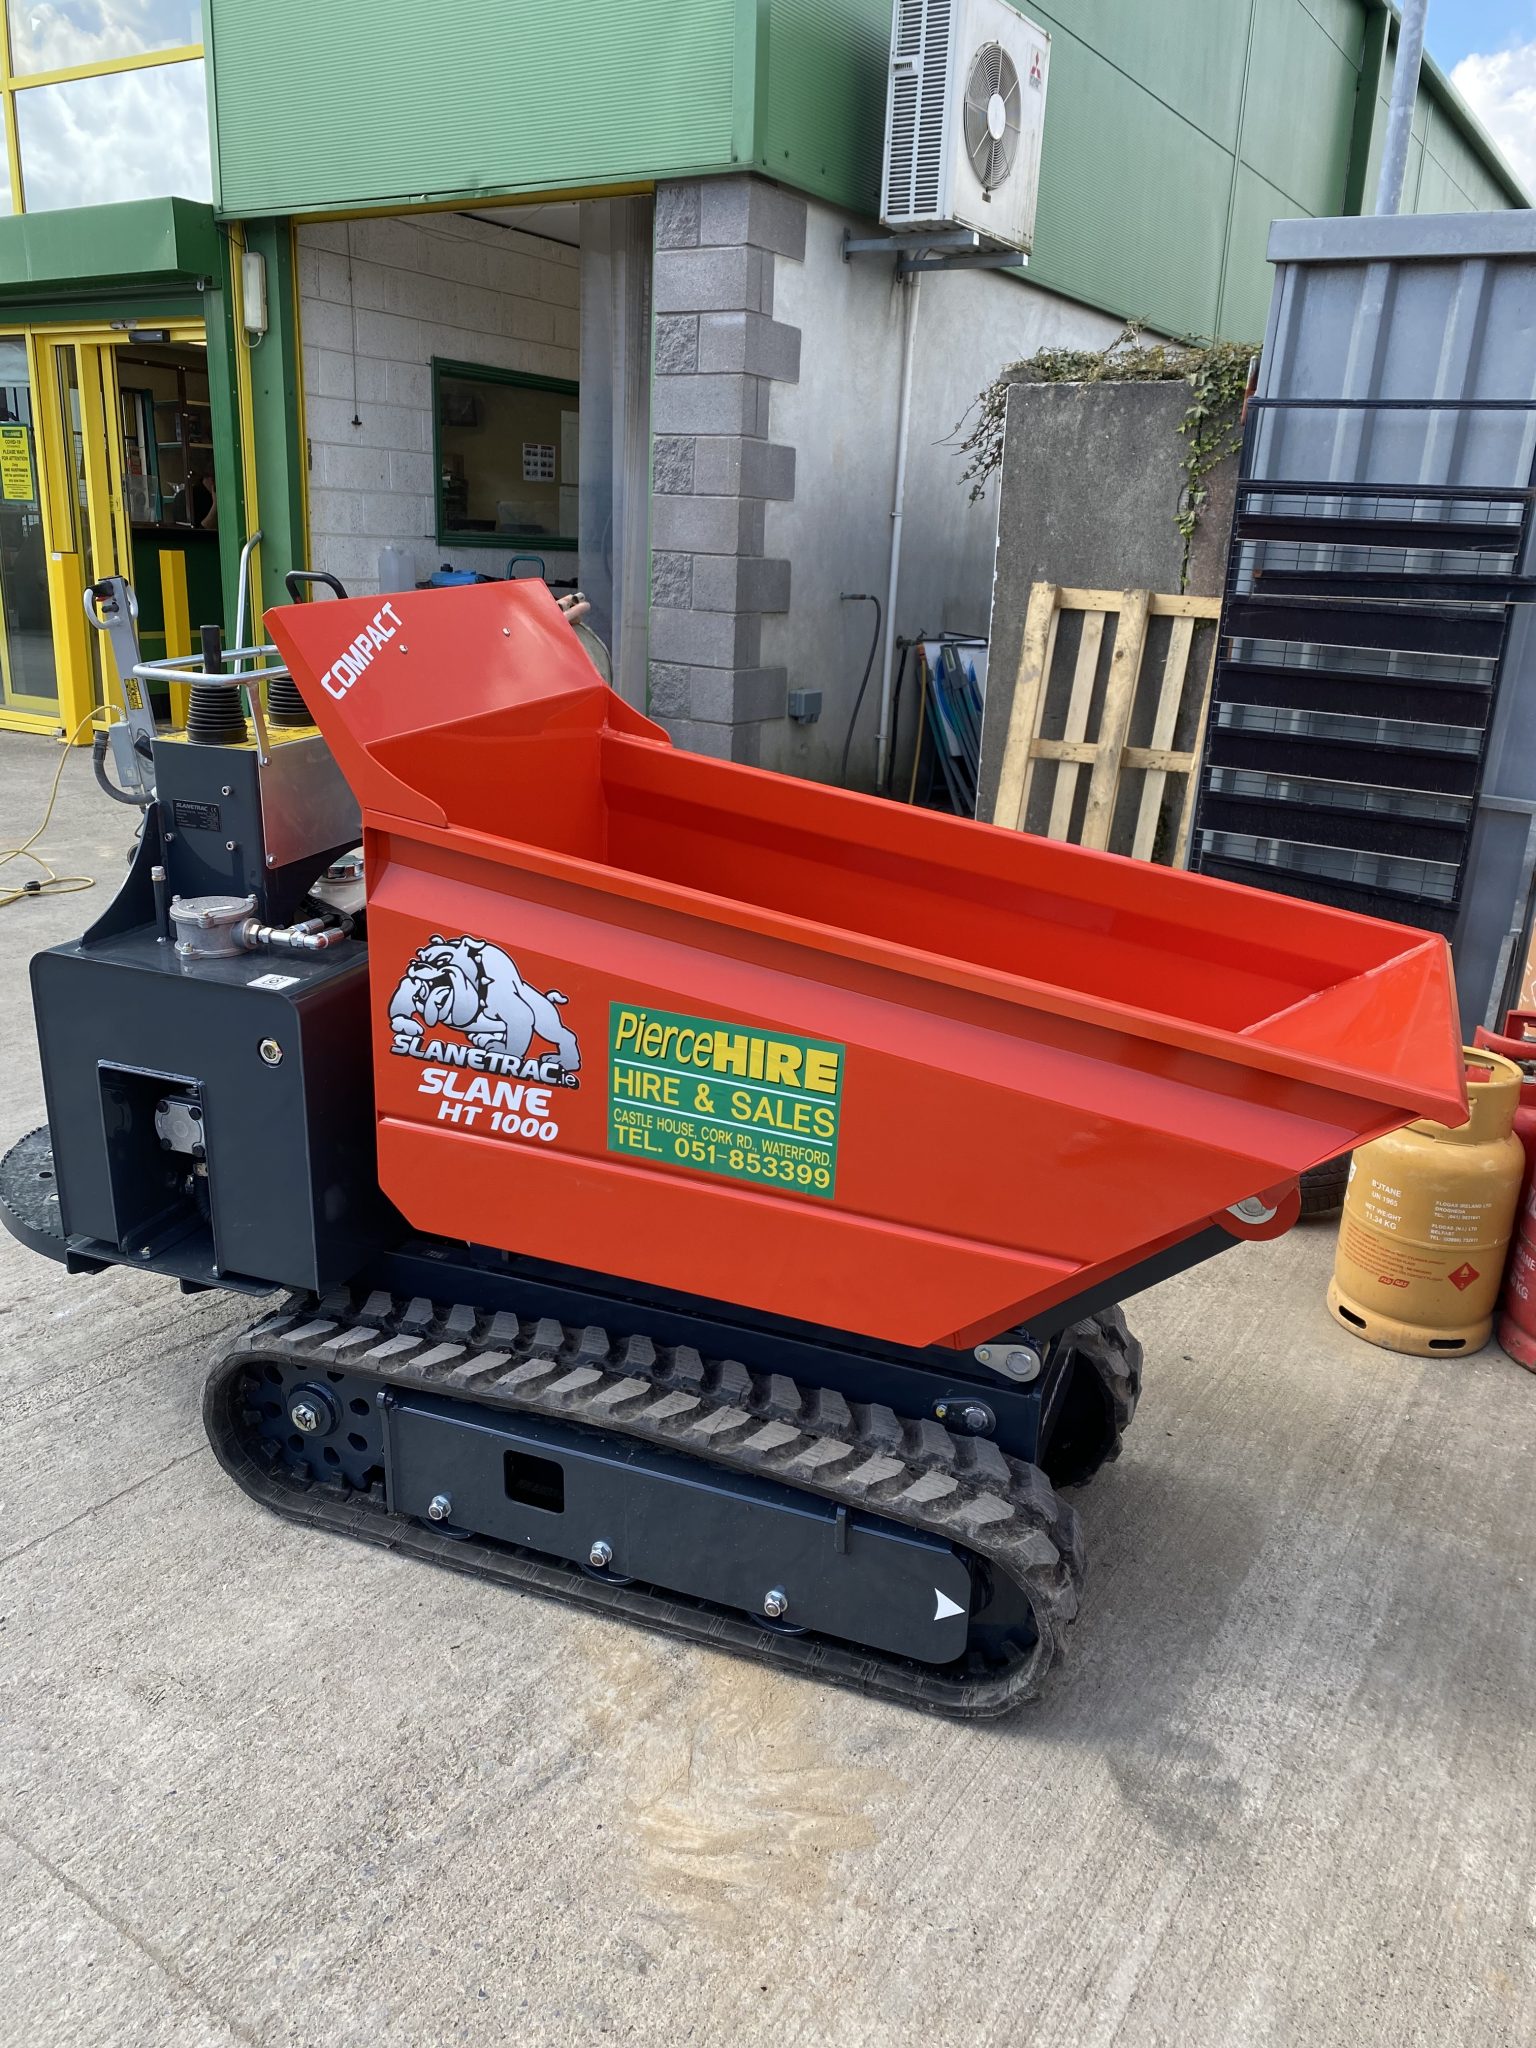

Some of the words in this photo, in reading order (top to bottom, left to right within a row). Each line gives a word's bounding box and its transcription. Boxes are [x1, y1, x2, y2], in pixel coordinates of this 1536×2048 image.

[320, 601, 403, 700] COMPACT
[175, 802, 208, 812] SLANETRAC
[417, 1067, 553, 1117] SLANE
[613, 1066, 681, 1106] HIRE
[693, 1083, 716, 1114] &
[731, 1090, 835, 1138] SALES
[437, 1100, 483, 1126] HT
[490, 1111, 559, 1142] 1000
[613, 1107, 653, 1129] CASTLE
[656, 1116, 698, 1140] HOUSE,
[701, 1125, 733, 1146] CORK
[761, 1138, 833, 1168] WATERFORD.
[613, 1123, 663, 1153] TEL.
[674, 1137, 831, 1189] 051-853399
[1371, 1179, 1402, 1198] BUTANE
[1371, 1190, 1381, 1201] UN
[1382, 1196, 1399, 1207] 1965
[1364, 1201, 1376, 1211] NET
[1376, 1207, 1403, 1222] WEIGHT
[1366, 1210, 1383, 1224] 11.34
[1384, 1219, 1397, 1230] KG
